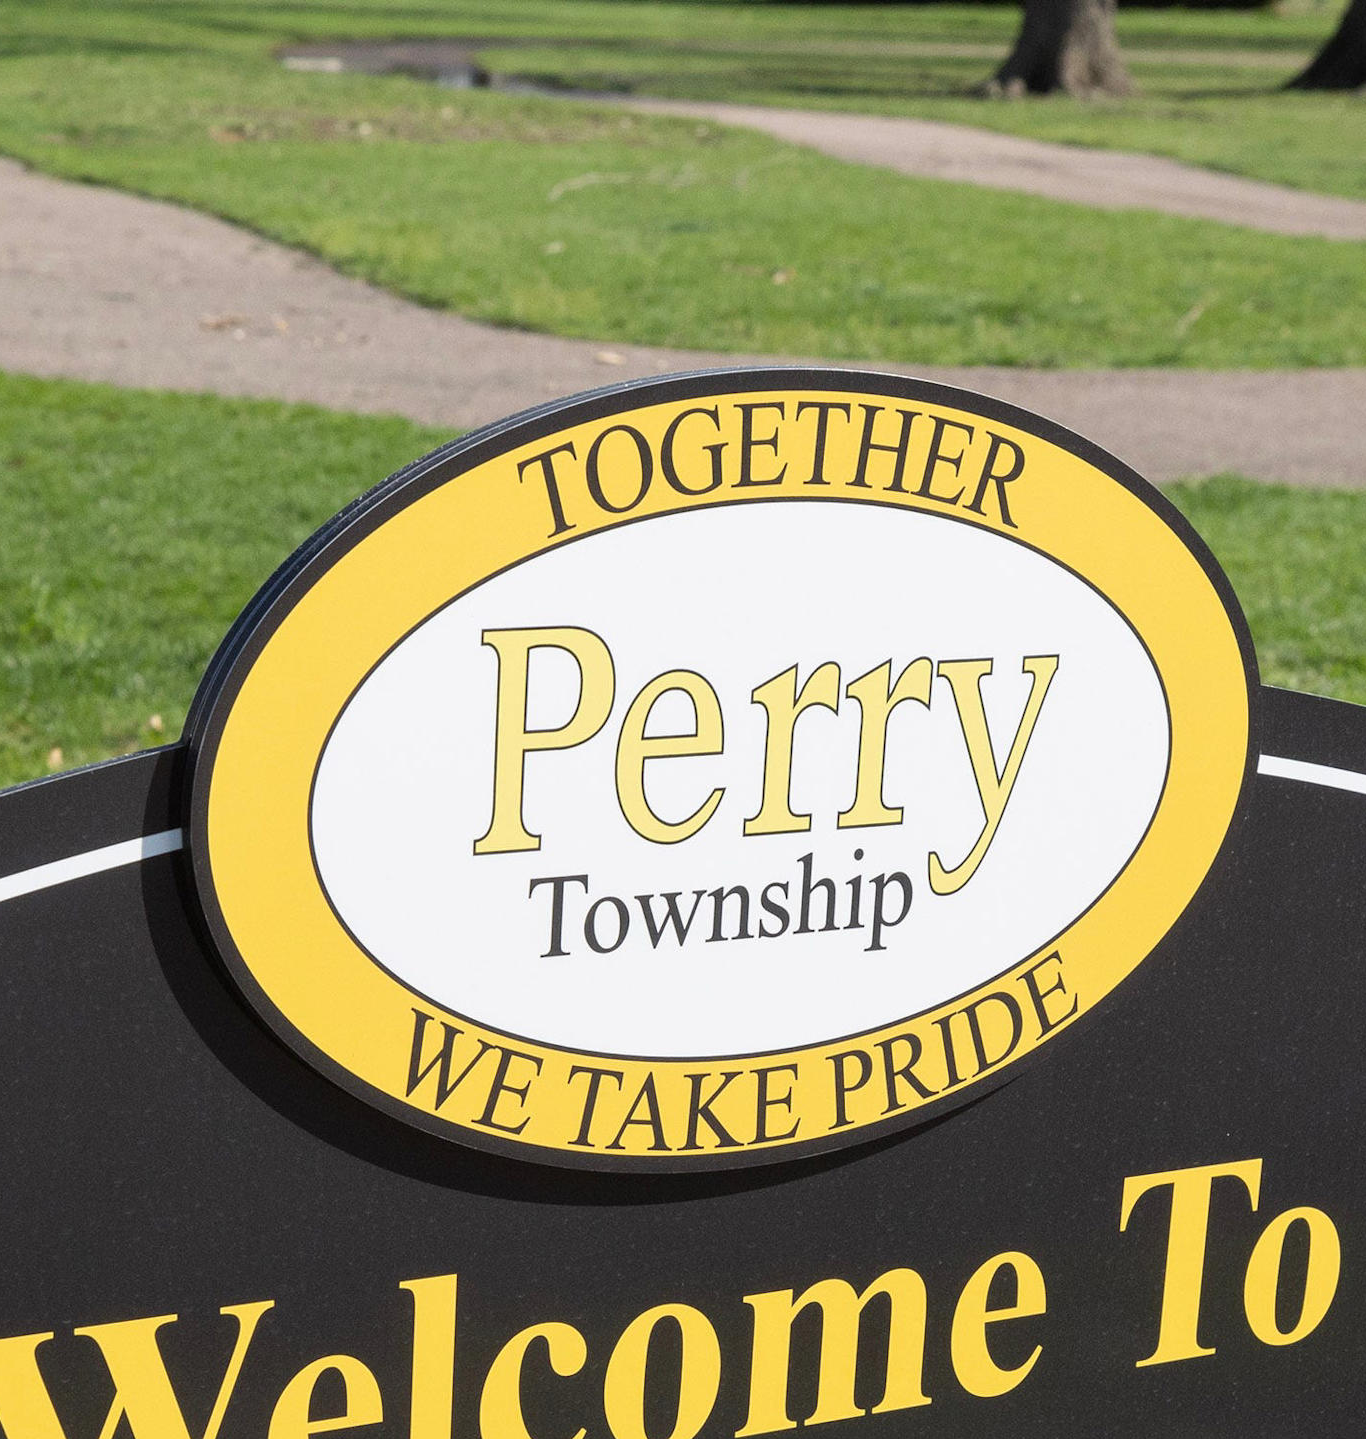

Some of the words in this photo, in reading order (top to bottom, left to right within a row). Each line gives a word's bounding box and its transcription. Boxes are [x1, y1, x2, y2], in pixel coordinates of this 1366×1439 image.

[517, 402, 1027, 538] TOGETHER
[471, 626, 1061, 896] Perry
[528, 848, 914, 959] Township
[404, 1007, 543, 1134] WE
[567, 1062, 802, 1154] TAKE
[825, 950, 1081, 1130] PRIDE
[1117, 1157, 1343, 1369] To
